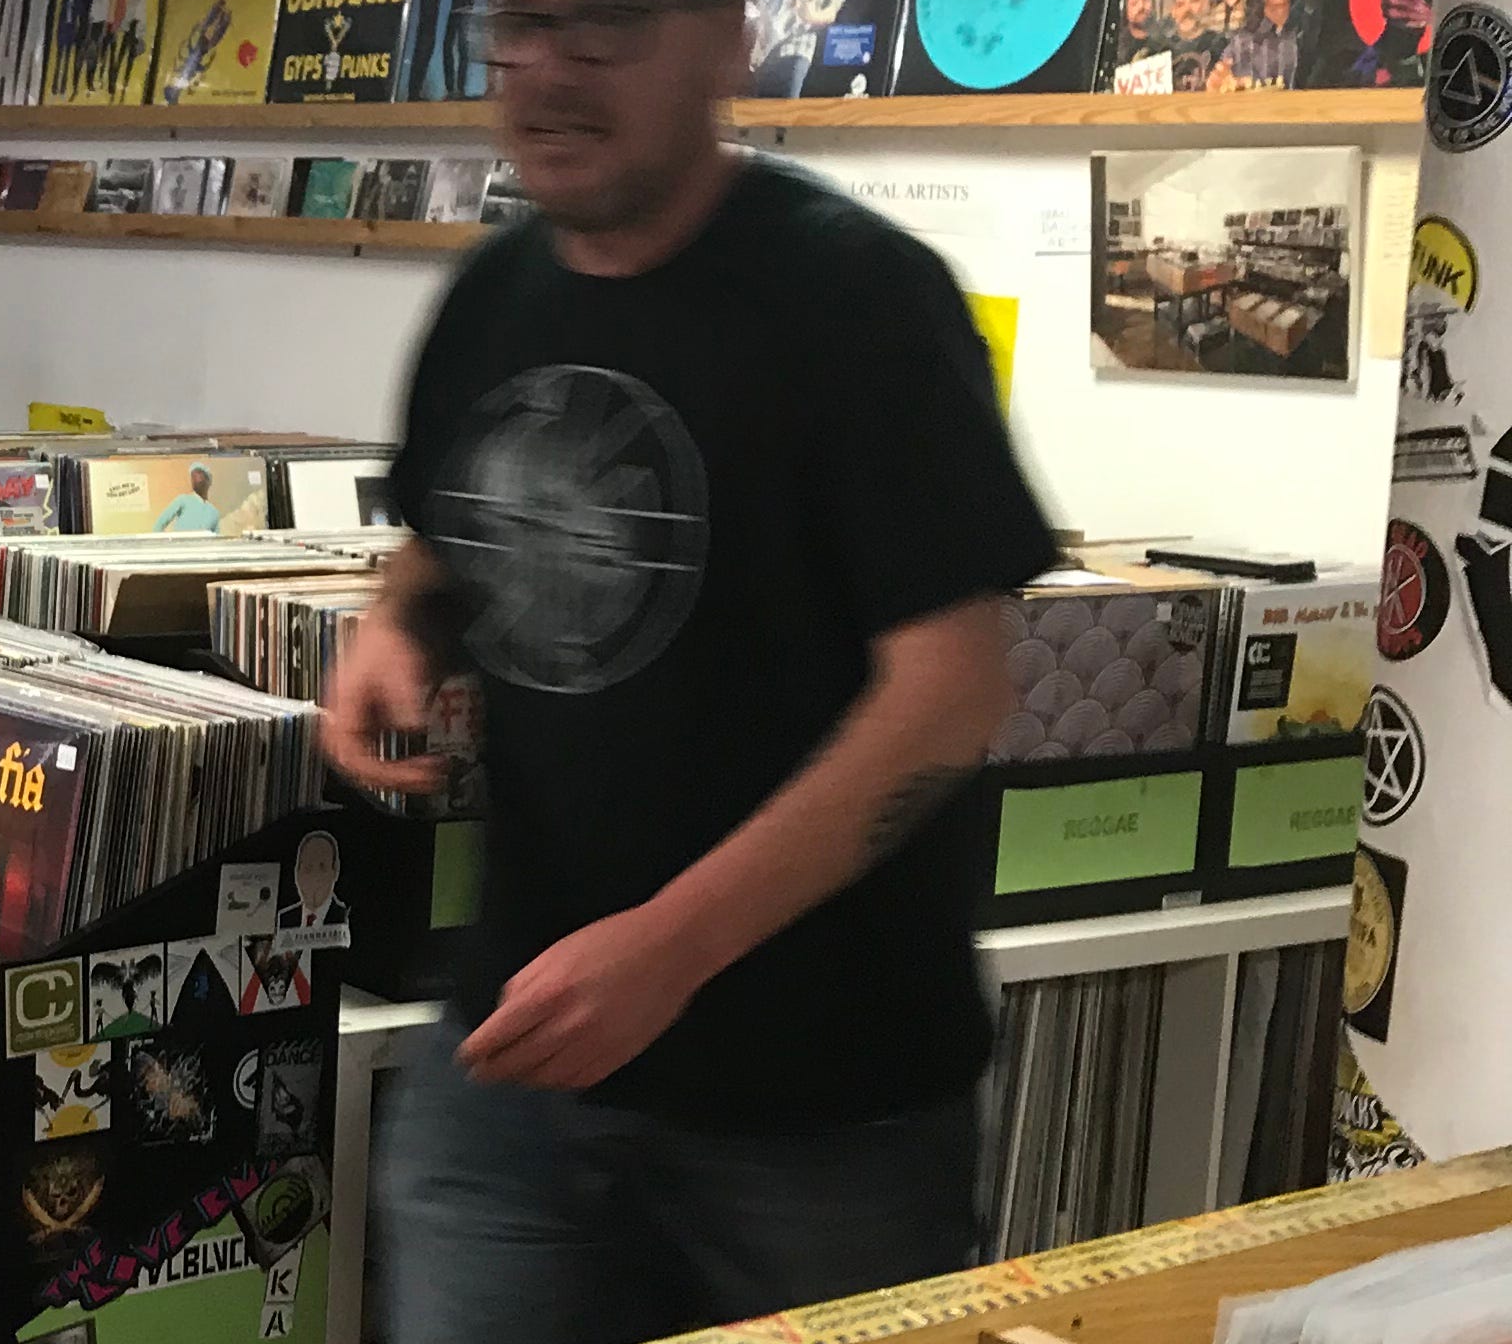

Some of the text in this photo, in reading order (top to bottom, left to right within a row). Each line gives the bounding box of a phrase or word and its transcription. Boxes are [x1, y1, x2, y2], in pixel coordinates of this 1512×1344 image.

[340, 53, 391, 79] PUNKS
[850, 181, 970, 202] LOCAL ARTISTS
[1063, 811, 1139, 841] REGGAE
[1289, 806, 1357, 833] REGGAE
